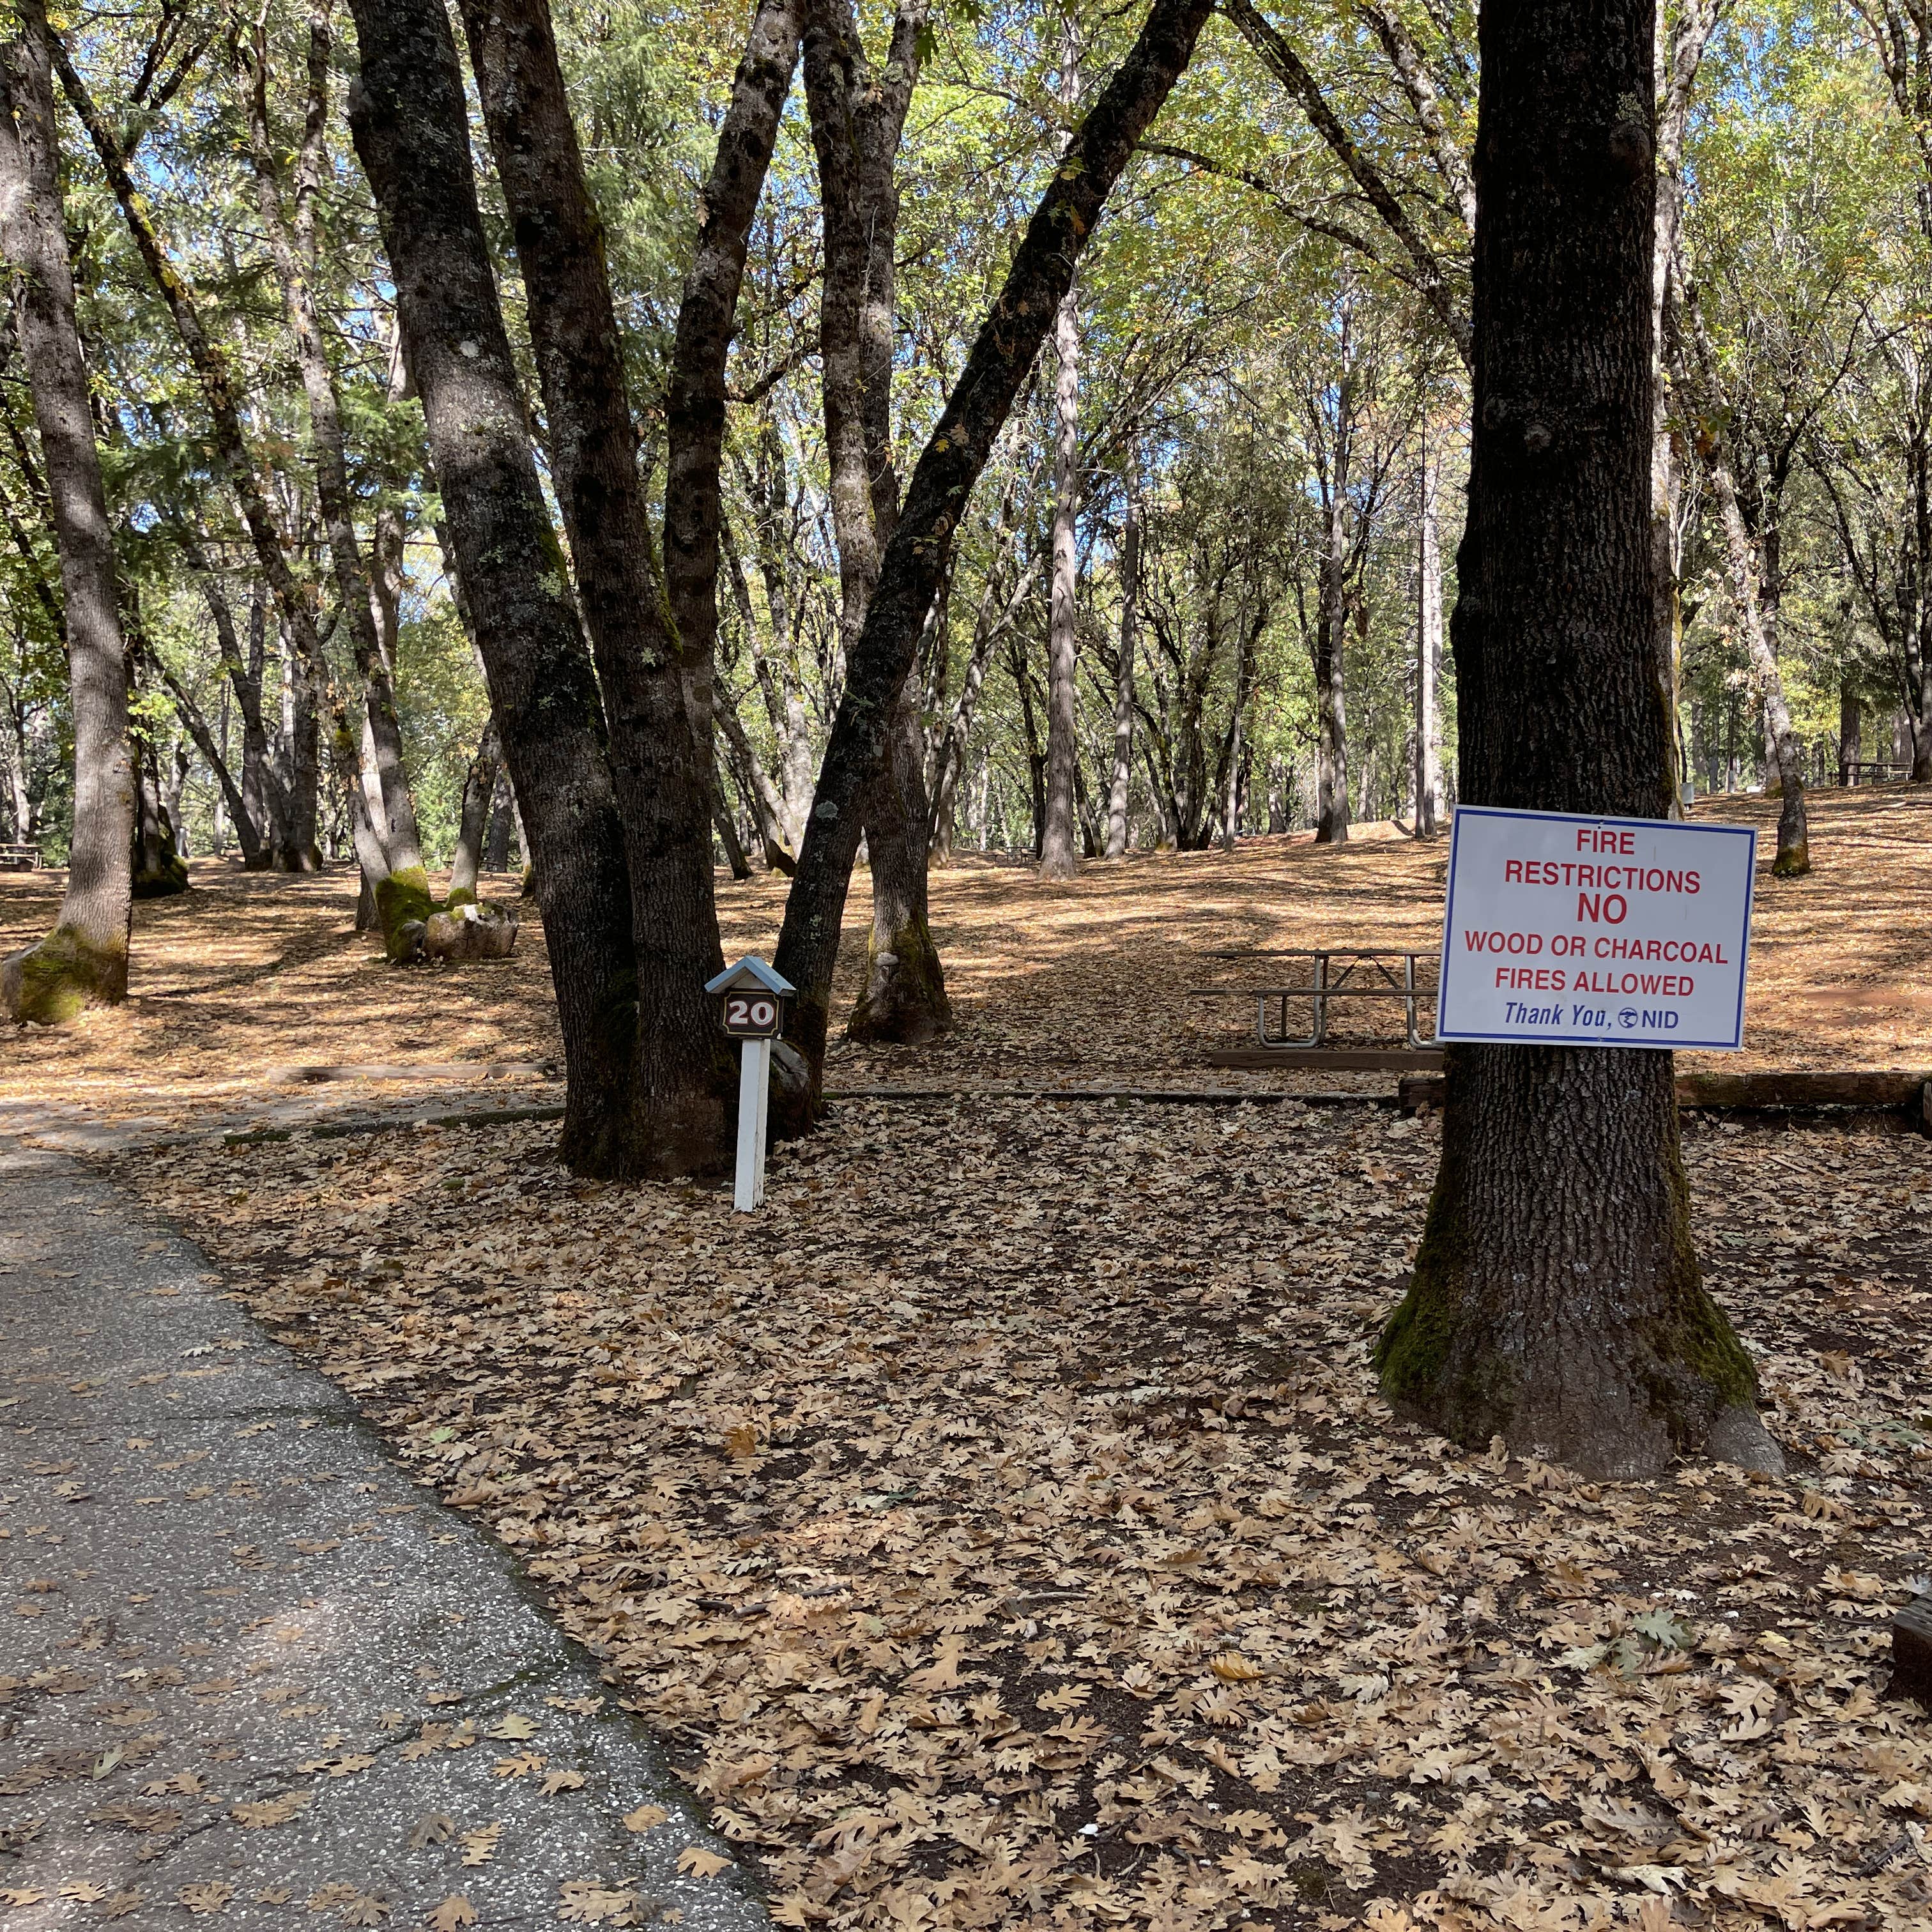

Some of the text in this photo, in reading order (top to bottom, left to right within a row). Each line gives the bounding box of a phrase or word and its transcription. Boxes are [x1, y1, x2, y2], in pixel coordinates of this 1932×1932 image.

[1576, 829, 1636, 855] FIRE
[1505, 859, 1701, 894] RESTRICTIONS
[1577, 893, 1628, 924] NO
[1465, 931, 1728, 964] WOOD OR CHARCOAL
[1495, 968, 1694, 997] FIRES ALLOWED
[729, 1000, 774, 1025] 20
[1505, 1002, 1678, 1030] Thank You, NID
